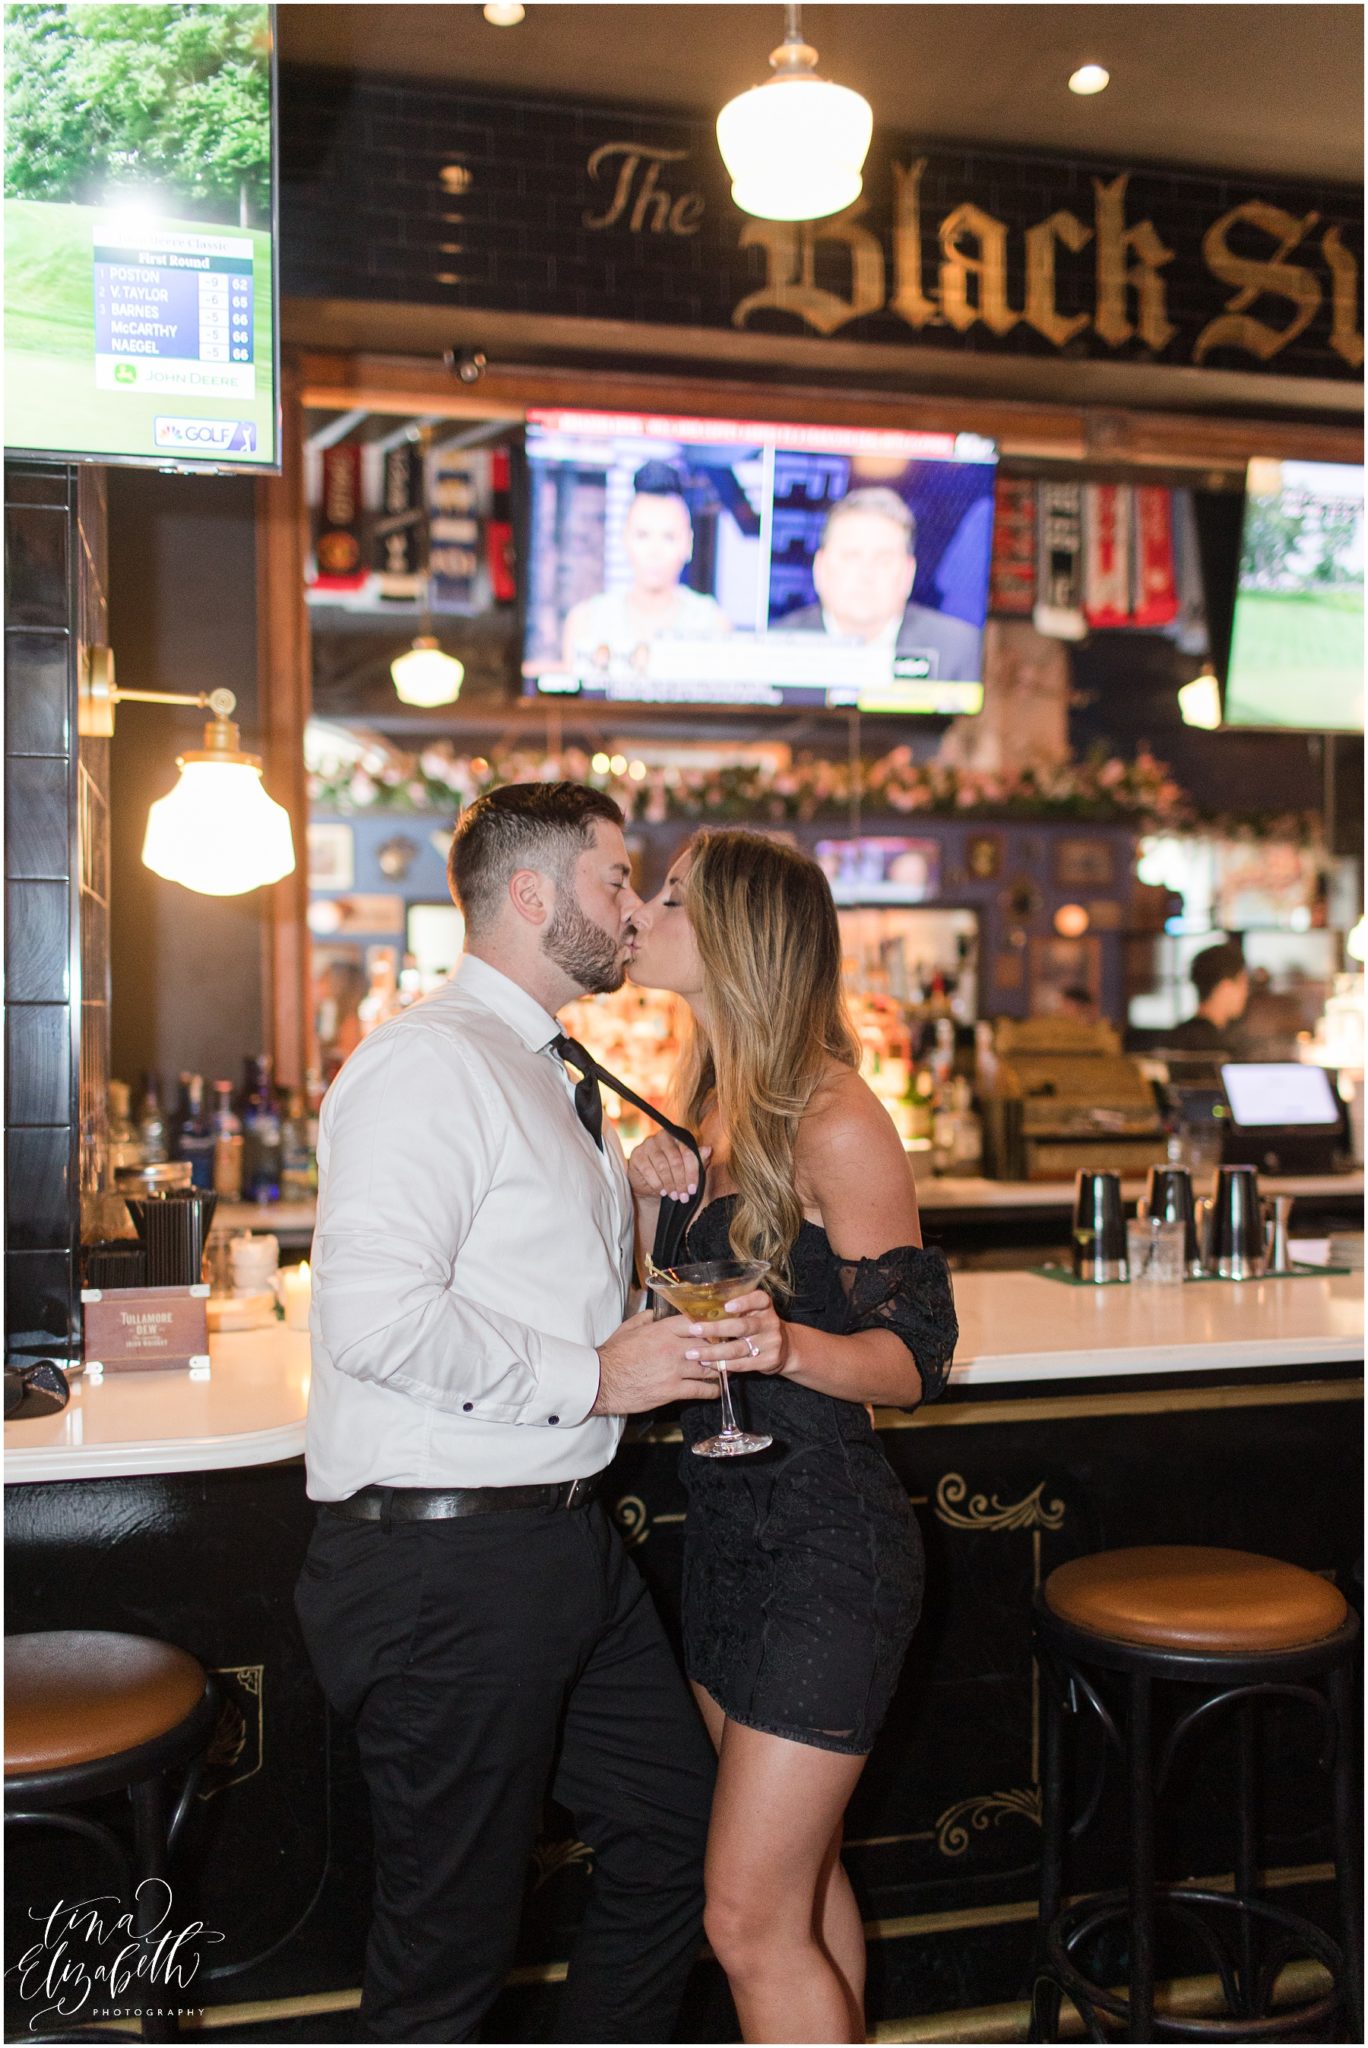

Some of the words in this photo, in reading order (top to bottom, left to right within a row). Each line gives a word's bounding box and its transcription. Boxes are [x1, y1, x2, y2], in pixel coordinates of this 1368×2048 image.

[582, 141, 707, 236] The
[730, 157, 1179, 352] Black
[138, 252, 167, 266] First
[170, 255, 210, 269] Round
[109, 267, 160, 284] POSTON
[232, 278, 248, 291] 62
[123, 288, 168, 302] TAYLOR
[232, 296, 248, 308] 65
[111, 303, 159, 319] BARNES
[232, 313, 248, 326] 66
[111, 320, 177, 338] McCARTHY
[233, 331, 249, 344] 66
[111, 338, 160, 355] NAEGEL
[233, 348, 249, 361] 66
[145, 369, 186, 385] JOHN
[189, 372, 240, 388] DEERE
[185, 426, 230, 443] GOLF
[120, 1312, 173, 1325] TULLAMORE
